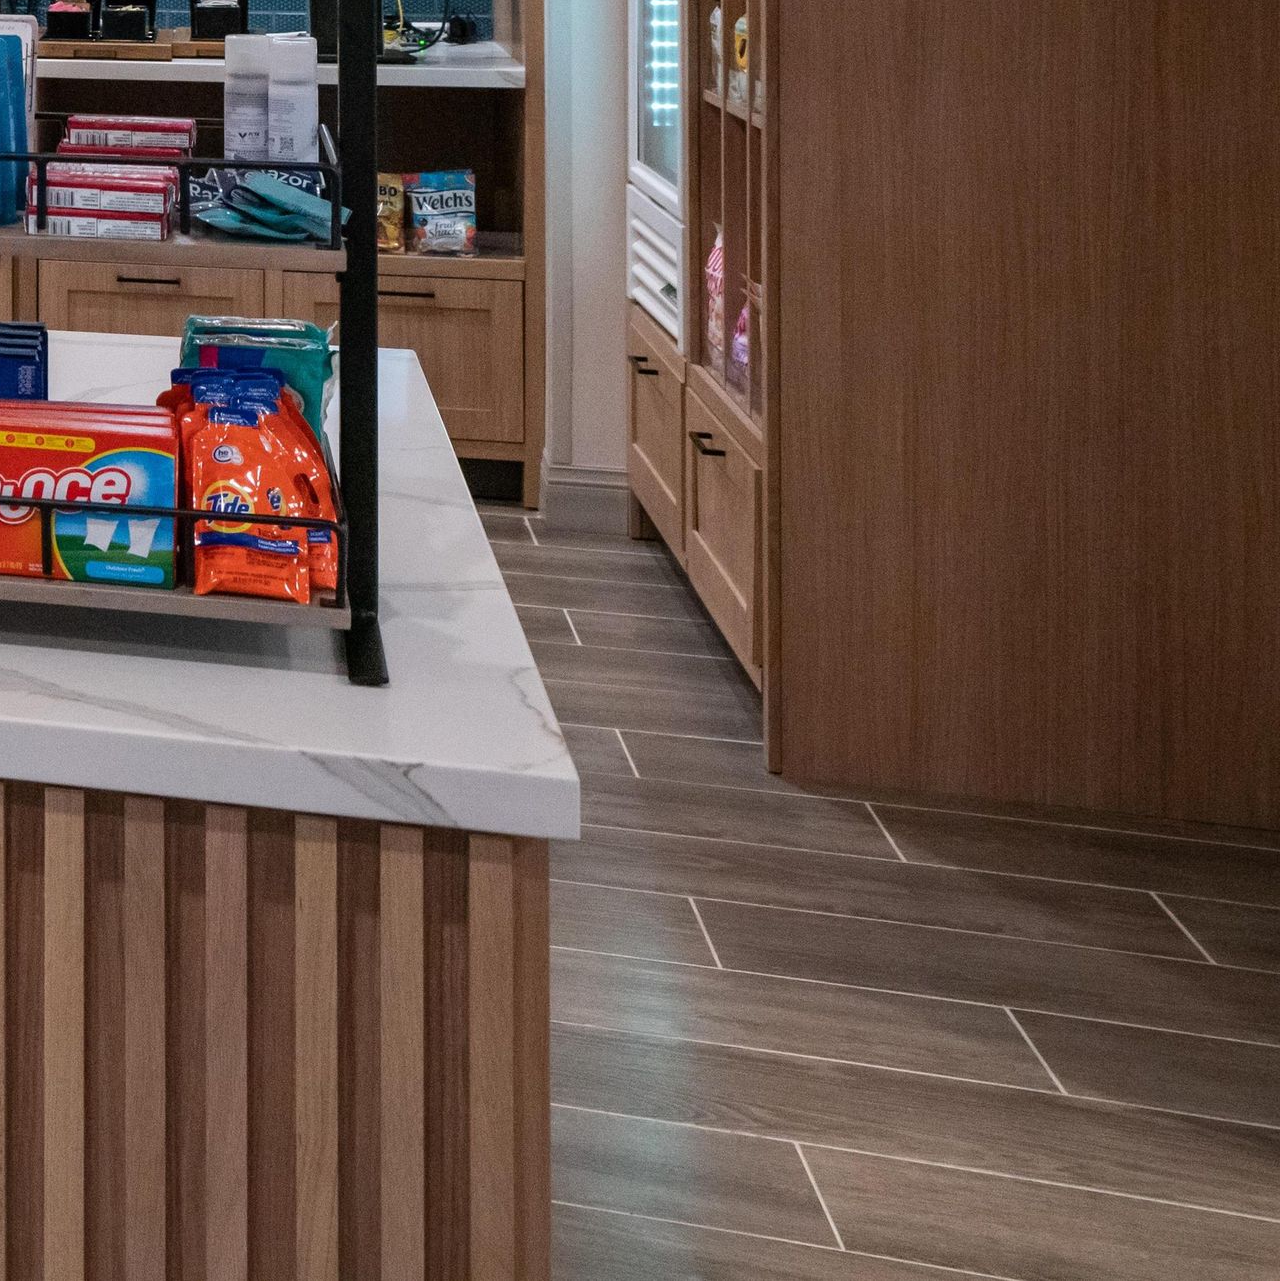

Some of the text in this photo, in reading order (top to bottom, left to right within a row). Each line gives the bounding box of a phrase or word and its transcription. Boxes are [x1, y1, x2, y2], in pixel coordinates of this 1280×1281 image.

[262, 169, 312, 189] azor
[189, 183, 223, 201] Raz
[414, 192, 473, 211] Welch's
[428, 227, 463, 239] Snacks
[218, 449, 229, 457] he
[206, 491, 250, 522] Tide
